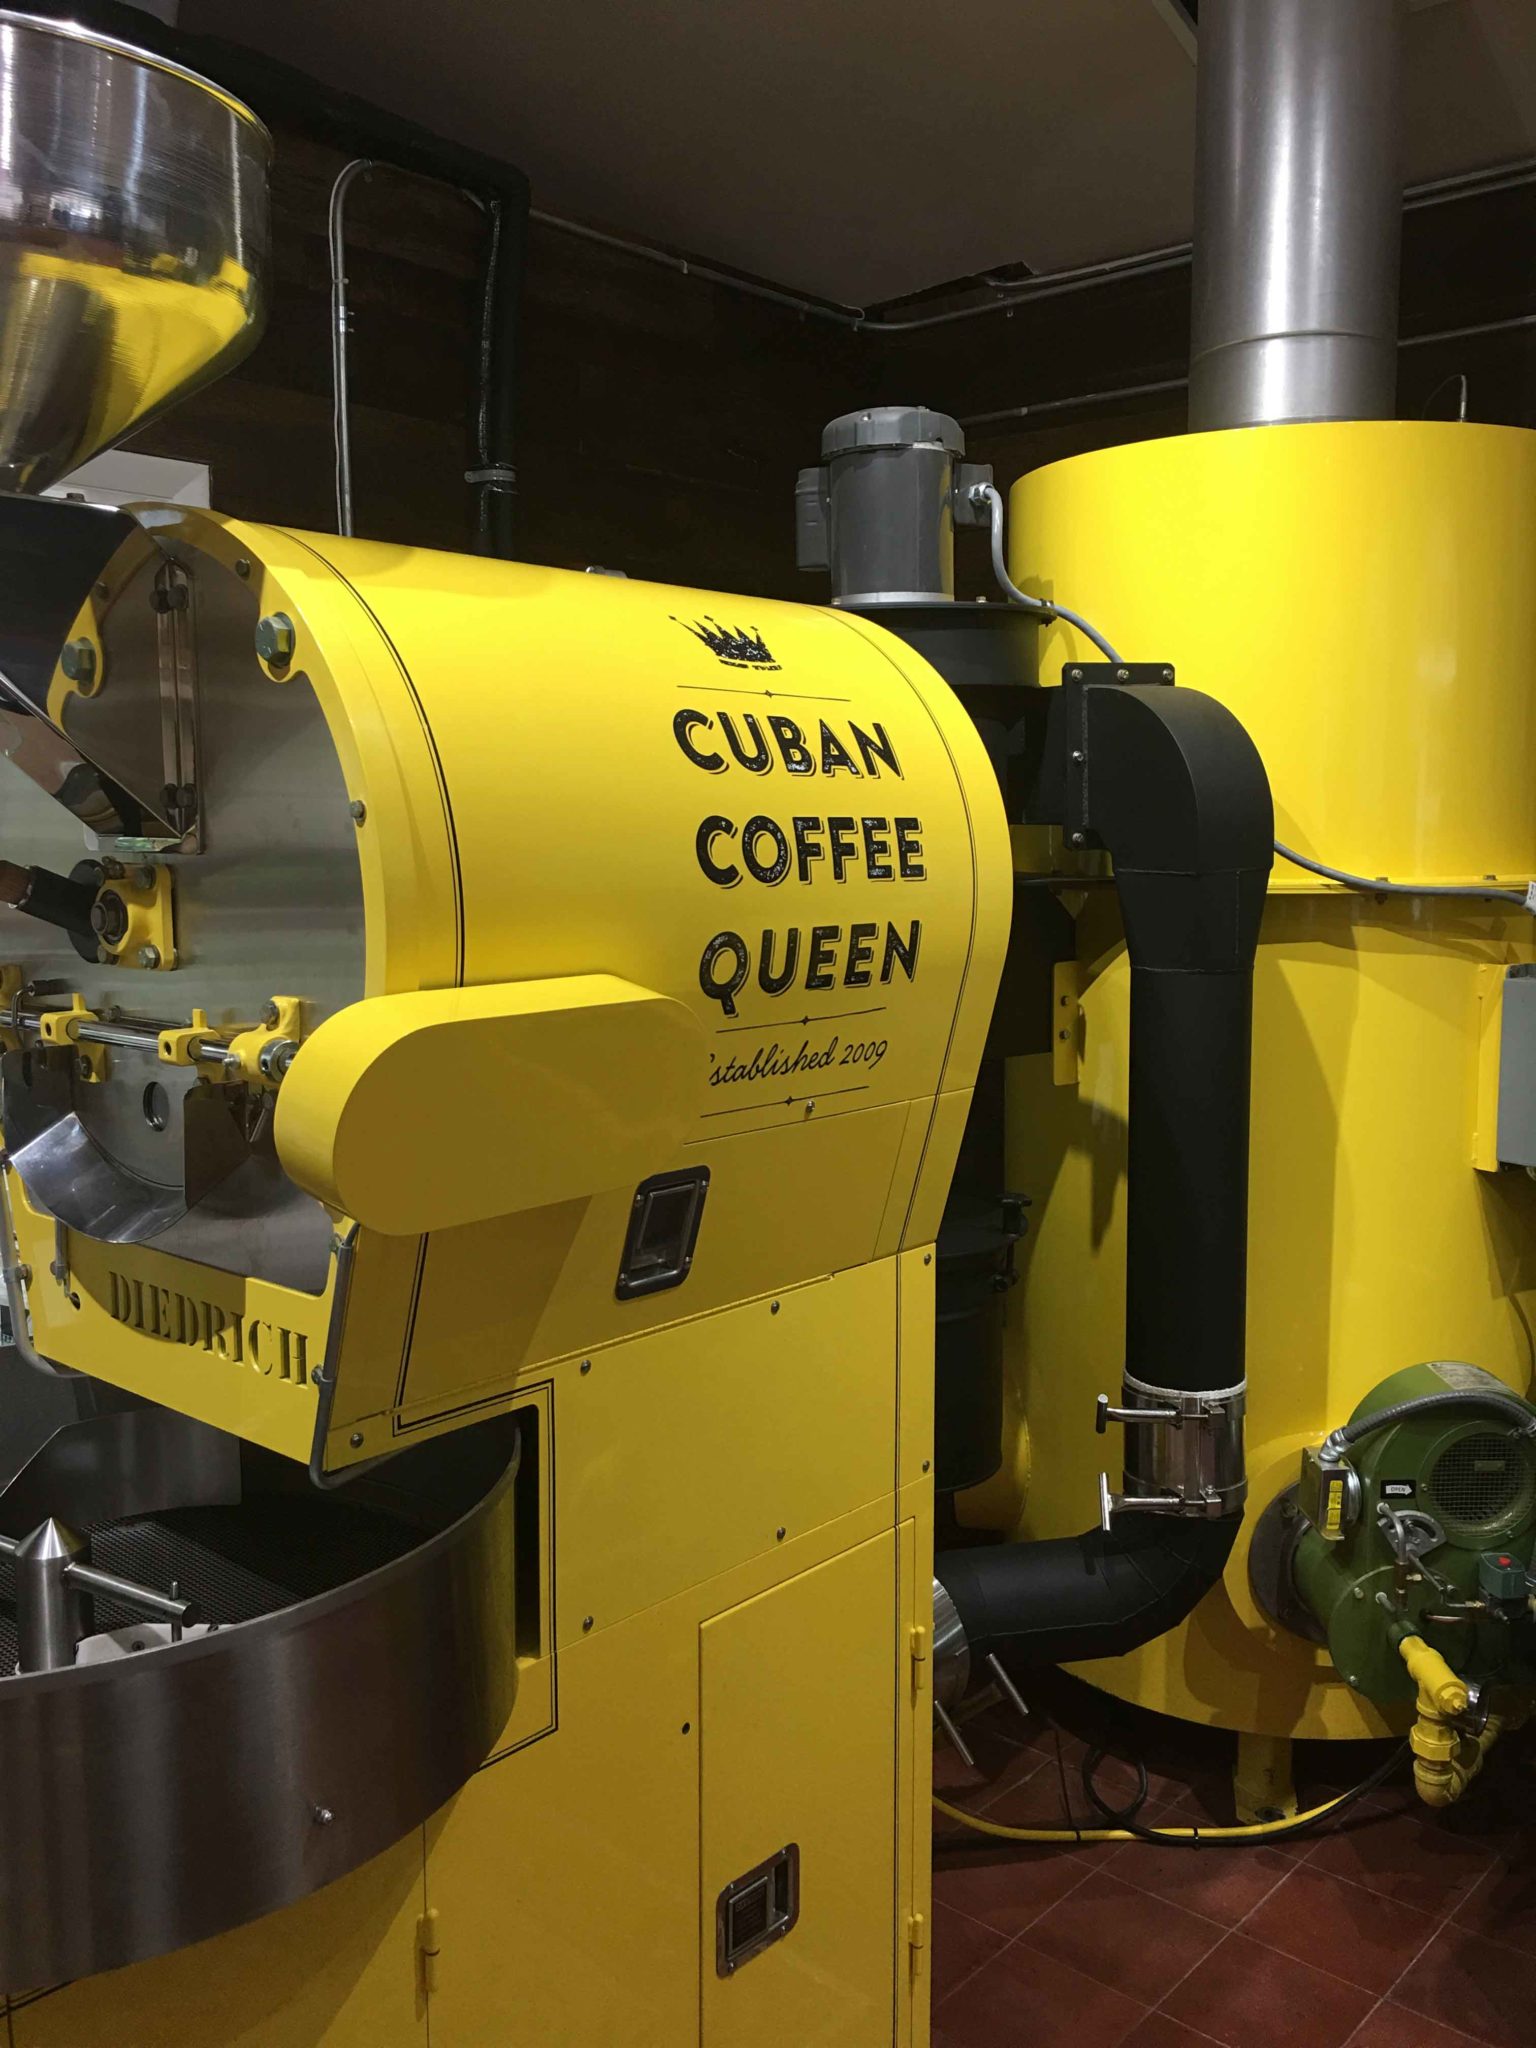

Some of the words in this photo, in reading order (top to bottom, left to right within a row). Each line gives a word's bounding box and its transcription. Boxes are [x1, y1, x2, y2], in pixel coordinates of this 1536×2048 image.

[673, 709, 904, 780] CUBAN
[695, 815, 927, 889] COFFEE
[699, 920, 922, 1018] QUEEN
[708, 1035, 838, 1087] stablished
[838, 1039, 888, 1070] 2009
[108, 1271, 309, 1389] DIEDRICH
